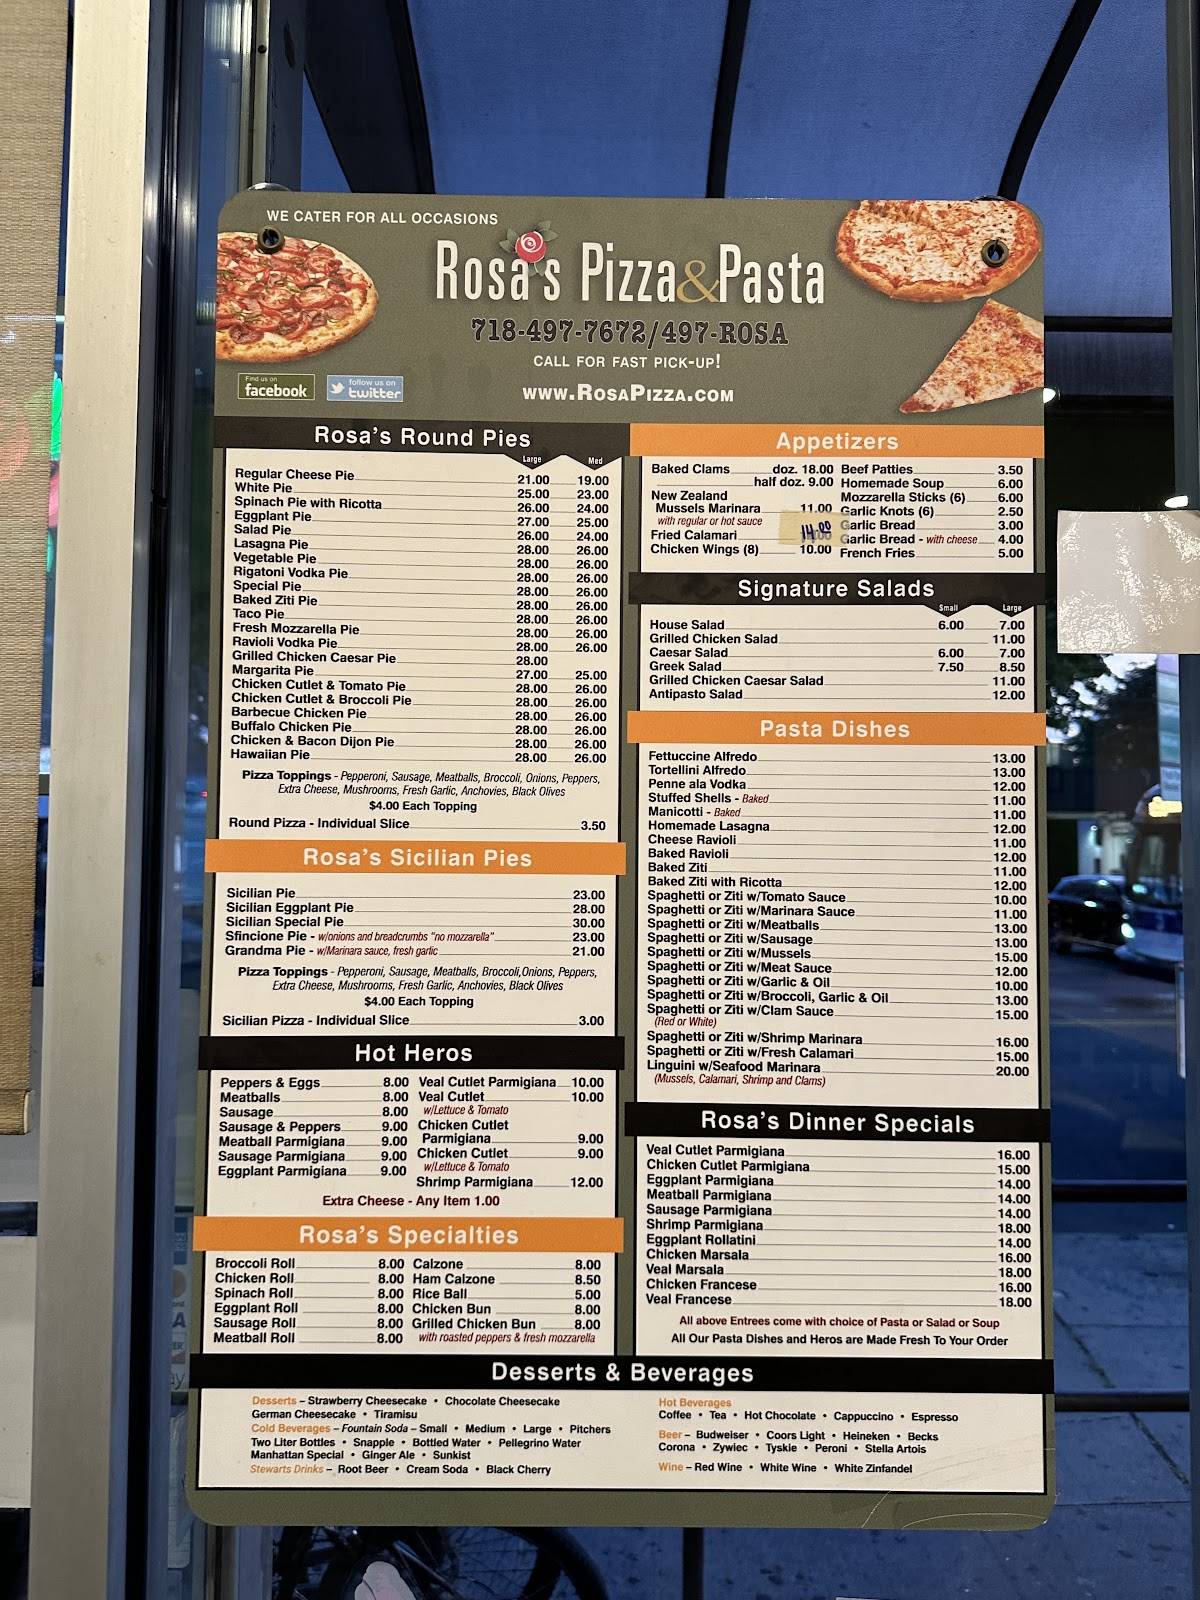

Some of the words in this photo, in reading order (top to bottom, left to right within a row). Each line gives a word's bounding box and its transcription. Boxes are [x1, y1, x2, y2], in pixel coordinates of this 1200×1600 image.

[267, 210, 288, 221] WE
[294, 210, 340, 222] CATER
[347, 212, 375, 222] FOR
[381, 212, 406, 223] ALL
[412, 212, 497, 224] OCCASIONS
[471, 319, 789, 348] 718-497-7672/497-ROSA
[534, 356, 570, 366] CALL
[577, 356, 604, 367] FOR
[613, 357, 647, 368] FAST
[655, 354, 720, 368] PICK-UP!
[245, 383, 308, 397] facebook
[349, 387, 401, 399] twitter
[316, 426, 391, 444] Rosa's
[402, 428, 472, 446] Round
[484, 430, 530, 447] Pies
[776, 432, 898, 453] Appetizers
[523, 456, 541, 464] Large
[652, 464, 688, 473] Baked
[693, 464, 730, 474] Clams
[773, 464, 797, 474] doz.
[802, 465, 833, 474] 18.00
[842, 464, 868, 474] Beef
[872, 464, 913, 474] Patties
[998, 466, 1023, 474] 3.50
[236, 468, 282, 480] Regular
[286, 469, 331, 480] Cheese
[336, 470, 354, 480] Pie
[518, 475, 549, 484] 21.00
[578, 476, 609, 485] 19.00
[755, 477, 776, 486] half
[780, 477, 804, 486] doz.
[809, 477, 833, 486] 9.00
[652, 490, 677, 500] New
[680, 491, 727, 500] Zealand
[235, 496, 283, 508] Spinach
[288, 497, 306, 507] Pie
[310, 498, 335, 508] with
[340, 499, 382, 509] Ricotta
[518, 503, 549, 512] 26.00
[577, 504, 608, 513] 24.00
[658, 516, 675, 525] with
[678, 516, 708, 527] regular
[721, 516, 735, 525] hot
[801, 520, 832, 542] 14.00
[739, 580, 848, 601] Signature
[858, 580, 934, 596] Salads
[1003, 604, 1022, 612] Large
[650, 620, 688, 629] House
[692, 620, 724, 629] Salad
[939, 621, 964, 630] 6.00
[1000, 621, 1024, 630] 7.00
[761, 720, 822, 737] Pasta
[833, 720, 910, 737] Dishes
[649, 751, 710, 761] Fettuccine
[714, 752, 757, 761] Alfredo
[994, 754, 1025, 763] 13.00
[278, 784, 301, 793] Extra
[304, 784, 339, 795] Cheese,
[344, 785, 399, 796] Mushrooms,
[403, 785, 428, 794] Fresh
[431, 786, 458, 796] Garlic,
[461, 786, 508, 797] Anchovies,
[512, 786, 536, 796] Black
[540, 787, 565, 796] Olives
[649, 779, 685, 788] Penne
[689, 779, 706, 788] ala
[710, 779, 746, 789] Vodka
[994, 782, 1026, 791] 12.00
[370, 801, 399, 810] $4.00
[403, 801, 429, 810] Each
[433, 802, 476, 813] Topping
[304, 848, 381, 865] Rosa's
[391, 848, 474, 866] Sicilian
[485, 850, 531, 866] Pies
[227, 888, 272, 898] Sicilian
[276, 888, 295, 898] Pie
[574, 890, 605, 900] 23.00
[655, 1016, 675, 1027] (Red
[690, 1017, 716, 1028] White)
[648, 1031, 704, 1043] Spaghetti
[725, 1032, 743, 1042] Ziti
[748, 1032, 804, 1045] w/Shrimp
[809, 1033, 862, 1044] Marinara
[996, 1038, 1028, 1047] 16.00
[356, 1044, 395, 1062] Hot
[406, 1044, 472, 1061] Heros
[221, 1078, 272, 1090] Peppers
[276, 1078, 284, 1087] &
[289, 1078, 320, 1090] Eggs
[384, 1077, 409, 1087] 8.00
[424, 1105, 465, 1115] w/Lettuce
[468, 1105, 474, 1114] &
[478, 1105, 508, 1114] Tomato
[702, 1110, 779, 1129] Rosa's
[790, 1112, 866, 1131] Dinner
[875, 1114, 974, 1136] Specials
[647, 1144, 671, 1154] Veal
[676, 1144, 712, 1155] Cutlet
[717, 1145, 784, 1158] Parmigiana
[998, 1150, 1030, 1160] 16.00
[300, 1226, 378, 1244] Rosa's
[389, 1226, 518, 1248] Specialties
[216, 1258, 266, 1268] Broccoli
[271, 1258, 294, 1268] Roll
[379, 1259, 404, 1269] 8.00
[420, 1332, 437, 1342] with
[440, 1332, 474, 1342] roasted
[475, 1334, 511, 1344] peppers
[514, 1333, 520, 1342] &
[524, 1332, 546, 1342] fresh
[548, 1333, 595, 1342] mozzarella
[672, 1334, 685, 1342] All
[689, 1334, 709, 1342] Our
[713, 1334, 742, 1343] Pasta
[746, 1334, 783, 1343] Dishes
[787, 1334, 806, 1343] and
[810, 1334, 842, 1344] Heros
[867, 1335, 896, 1344] Made
[900, 1336, 930, 1344] Fresh
[933, 1336, 946, 1344] To
[949, 1336, 973, 1345] Your
[977, 1336, 1008, 1345] Order
[493, 1362, 596, 1381] Desserts
[606, 1363, 620, 1381] &
[632, 1363, 753, 1386] Beverages
[659, 1398, 676, 1407] Hot
[680, 1398, 732, 1409] Beverages
[659, 1442, 695, 1451] Corona
[713, 1443, 748, 1453] Zywiec
[766, 1443, 797, 1454] Tyskie
[816, 1444, 847, 1452] Peroni
[866, 1444, 893, 1452] Stella
[897, 1445, 926, 1453] Artois
